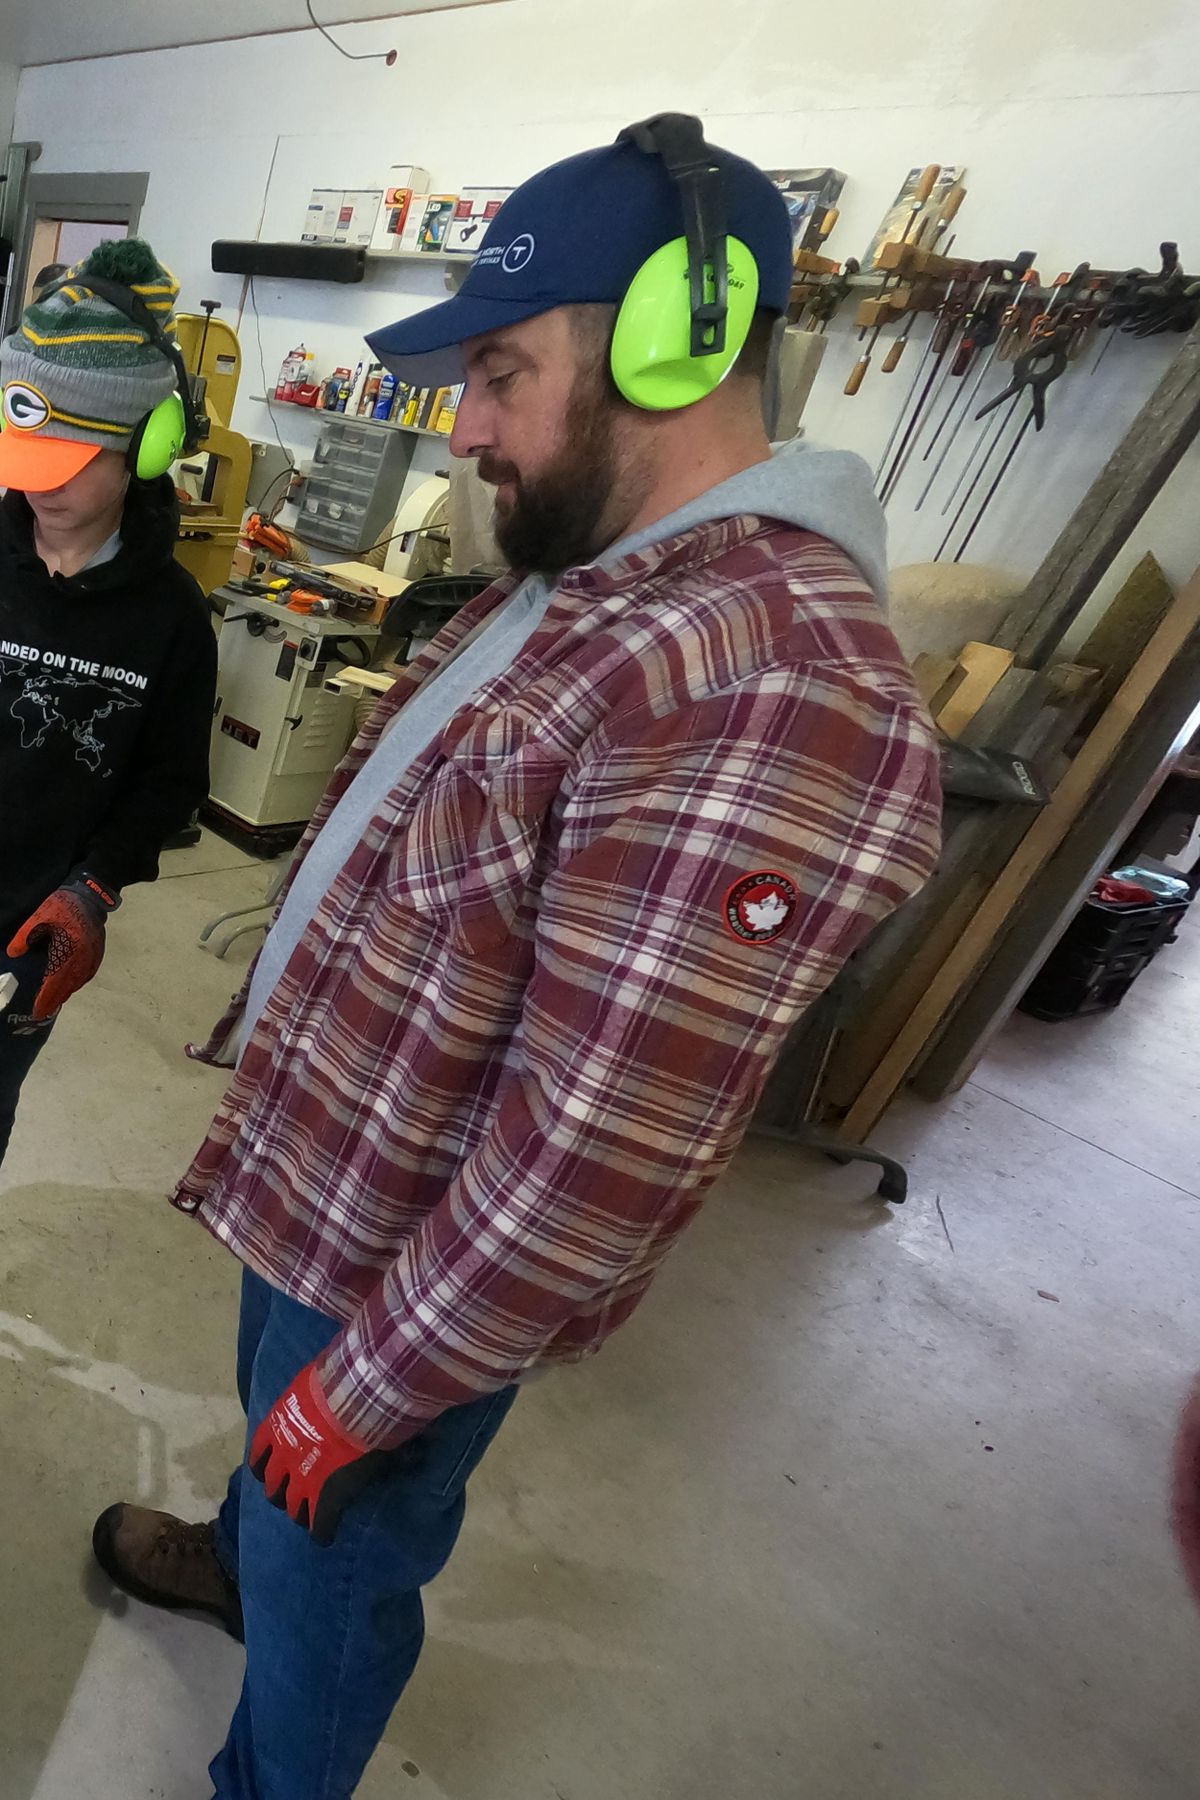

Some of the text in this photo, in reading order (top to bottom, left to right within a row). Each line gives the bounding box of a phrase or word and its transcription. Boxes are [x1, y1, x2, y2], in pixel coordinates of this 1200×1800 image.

[4, 385, 47, 428] G
[42, 651, 66, 668] ON
[69, 657, 100, 678] THE
[101, 665, 148, 690] MOON
[285, 1392, 324, 1441] Milwaukee
